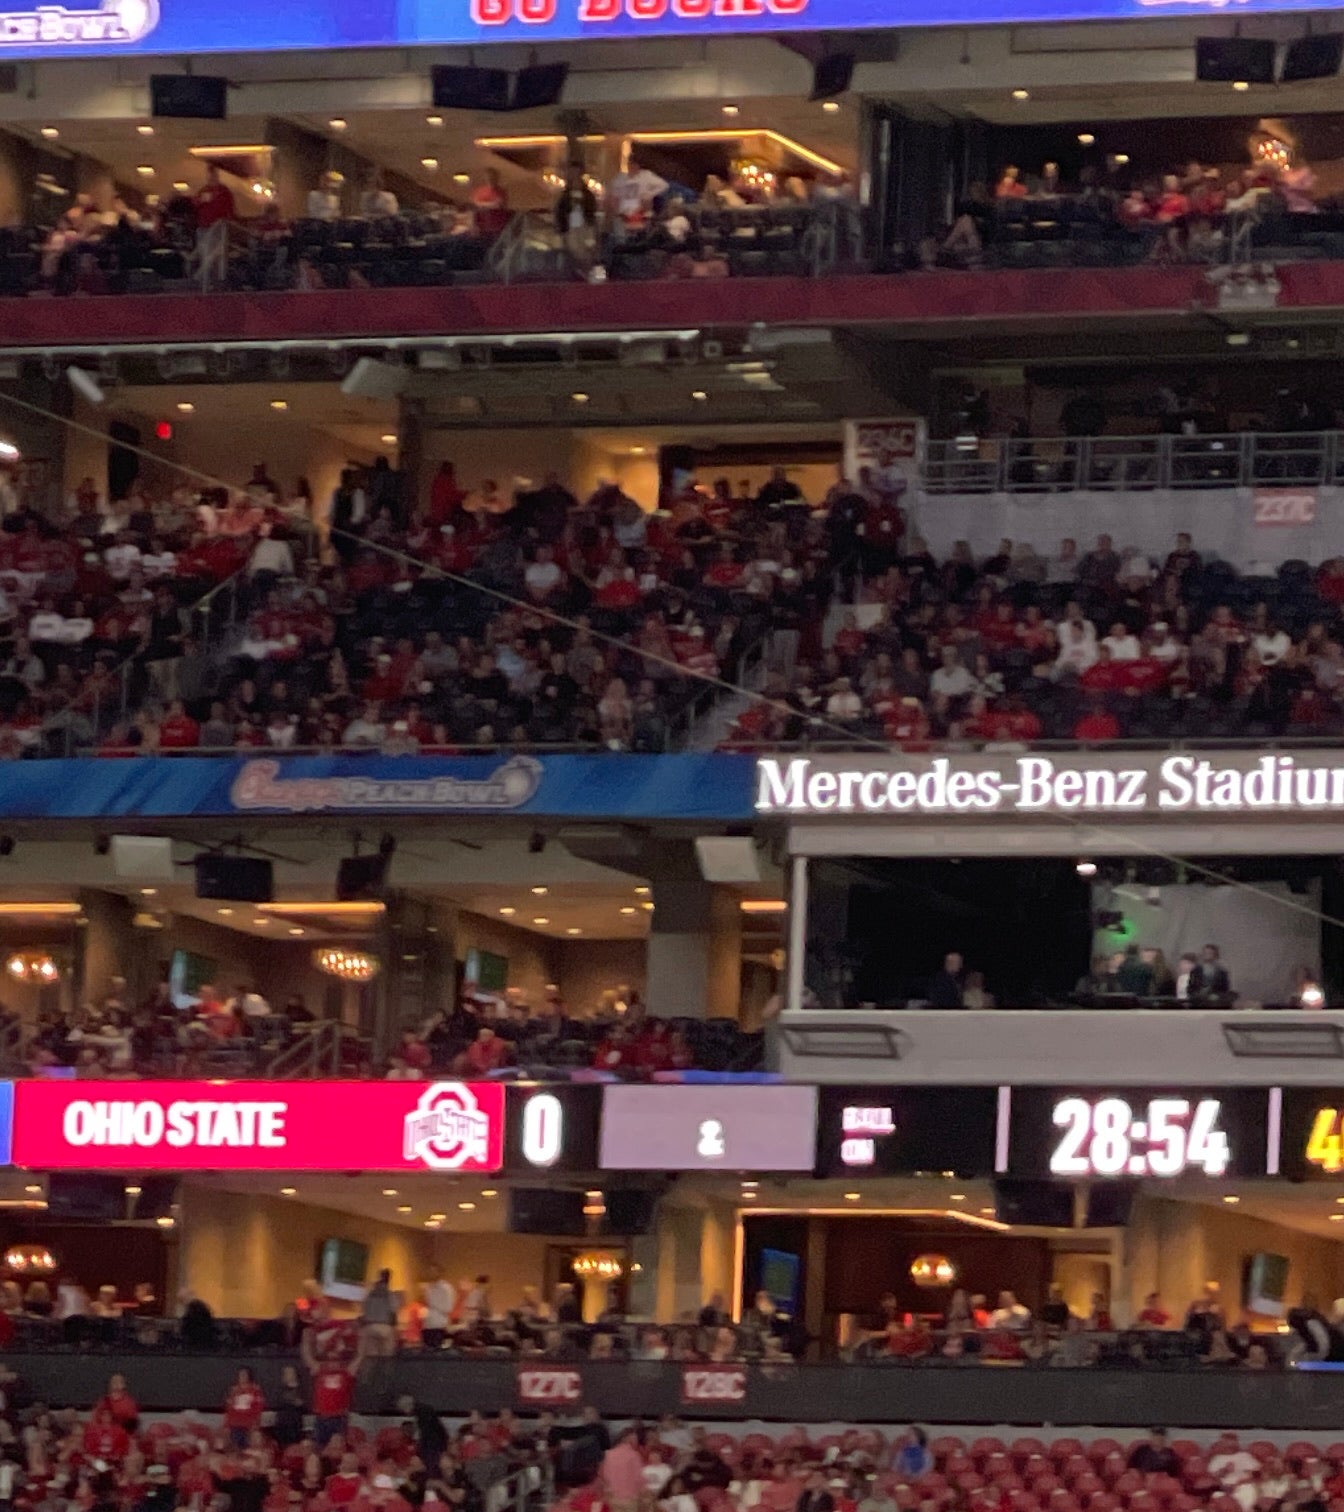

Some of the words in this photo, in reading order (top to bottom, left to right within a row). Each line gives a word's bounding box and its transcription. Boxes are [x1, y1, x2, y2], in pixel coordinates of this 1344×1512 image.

[754, 758, 1148, 809] Mercedes-Benz
[63, 1100, 165, 1147] OHIO
[165, 1100, 288, 1147] STATE
[523, 1094, 563, 1167] 0
[698, 1119, 725, 1156] &
[1049, 1097, 1231, 1176] 28:54
[518, 1370, 581, 1399] 127C
[683, 1370, 747, 1399] 128C
